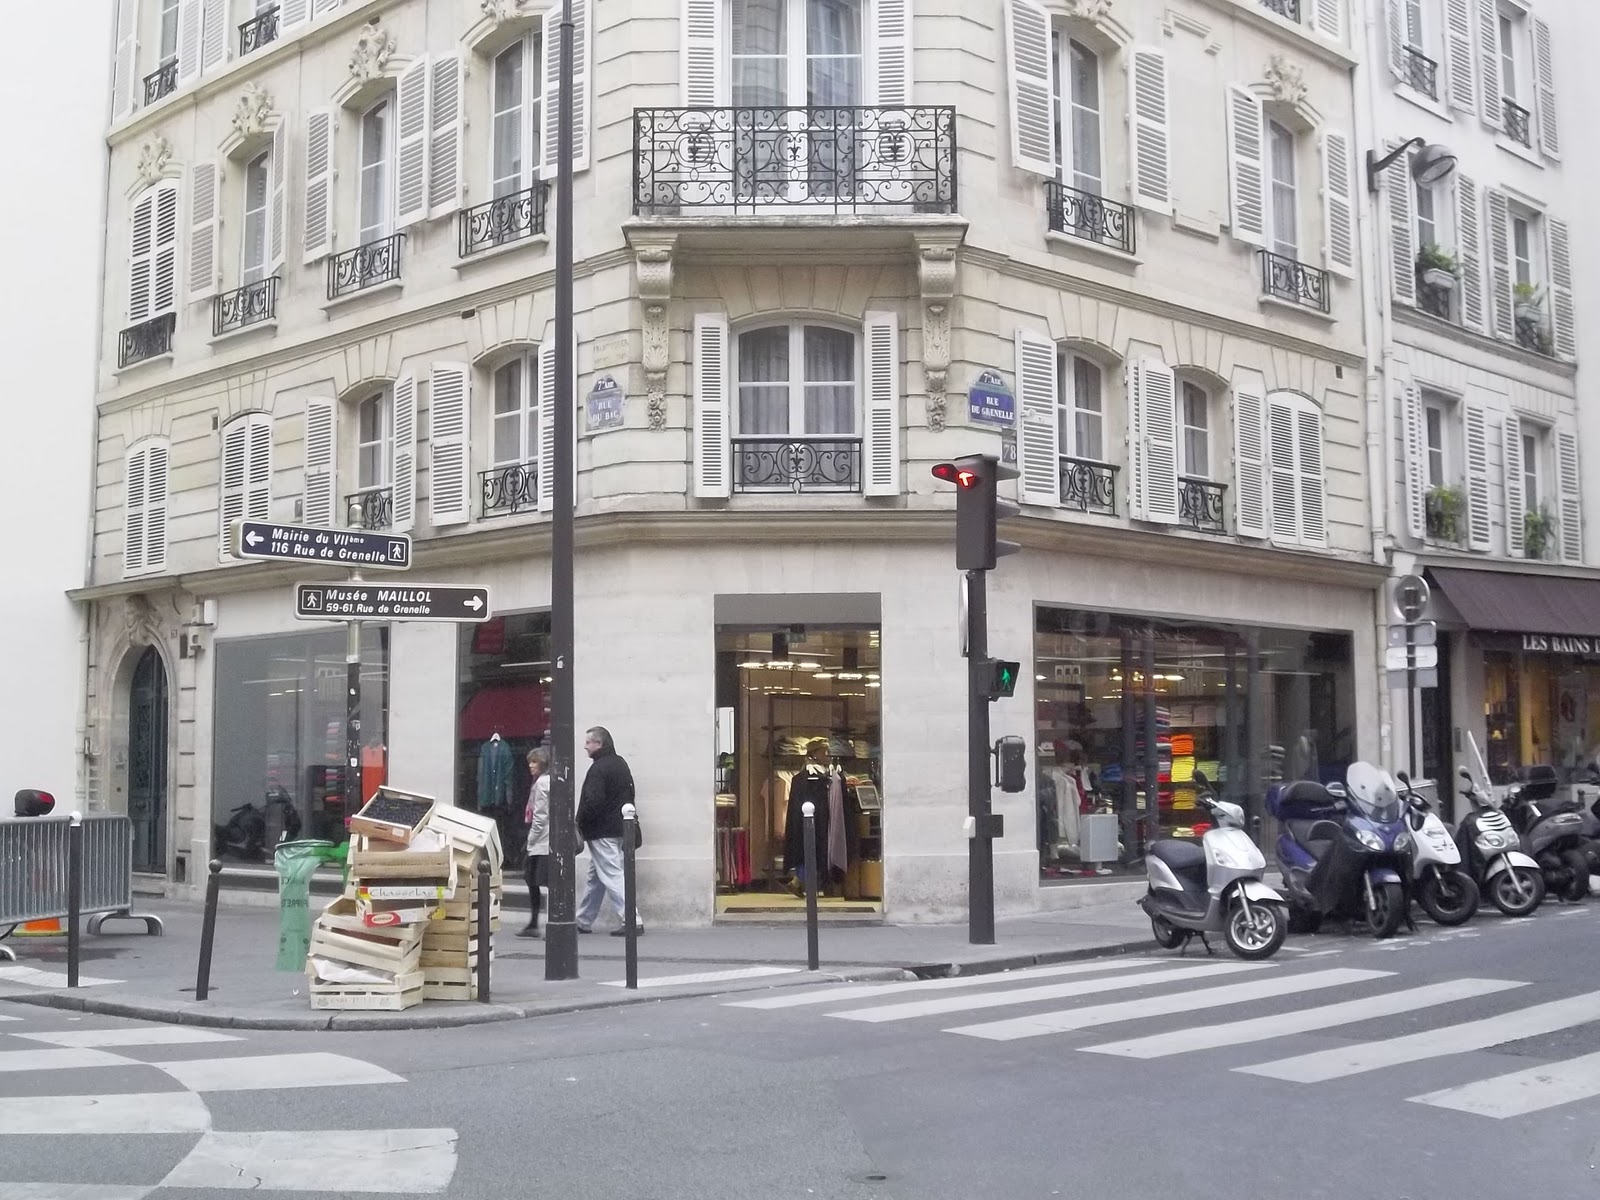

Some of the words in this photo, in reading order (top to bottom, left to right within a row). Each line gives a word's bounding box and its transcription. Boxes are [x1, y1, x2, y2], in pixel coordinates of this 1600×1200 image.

[598, 400, 613, 411] RUE
[986, 396, 1000, 407] RUE
[592, 413, 602, 421] DU
[605, 410, 620, 421] BAC
[971, 405, 981, 414] DE
[981, 407, 1015, 420] GRENELLE
[1003, 444, 1017, 460] 78
[271, 527, 310, 543] Mairie
[316, 532, 328, 544] du
[271, 541, 289, 554] 116
[294, 543, 316, 556] Rue
[320, 546, 334, 558] de
[338, 547, 386, 563] Grenelle
[325, 589, 368, 601] Musée
[377, 589, 432, 603] MAILLOL
[325, 602, 355, 614] 59-61,
[356, 603, 374, 614] Rue
[377, 604, 389, 614] de
[393, 604, 431, 614] Grenelle
[1522, 634, 1548, 651] LES
[1552, 636, 1590, 654] BAINS
